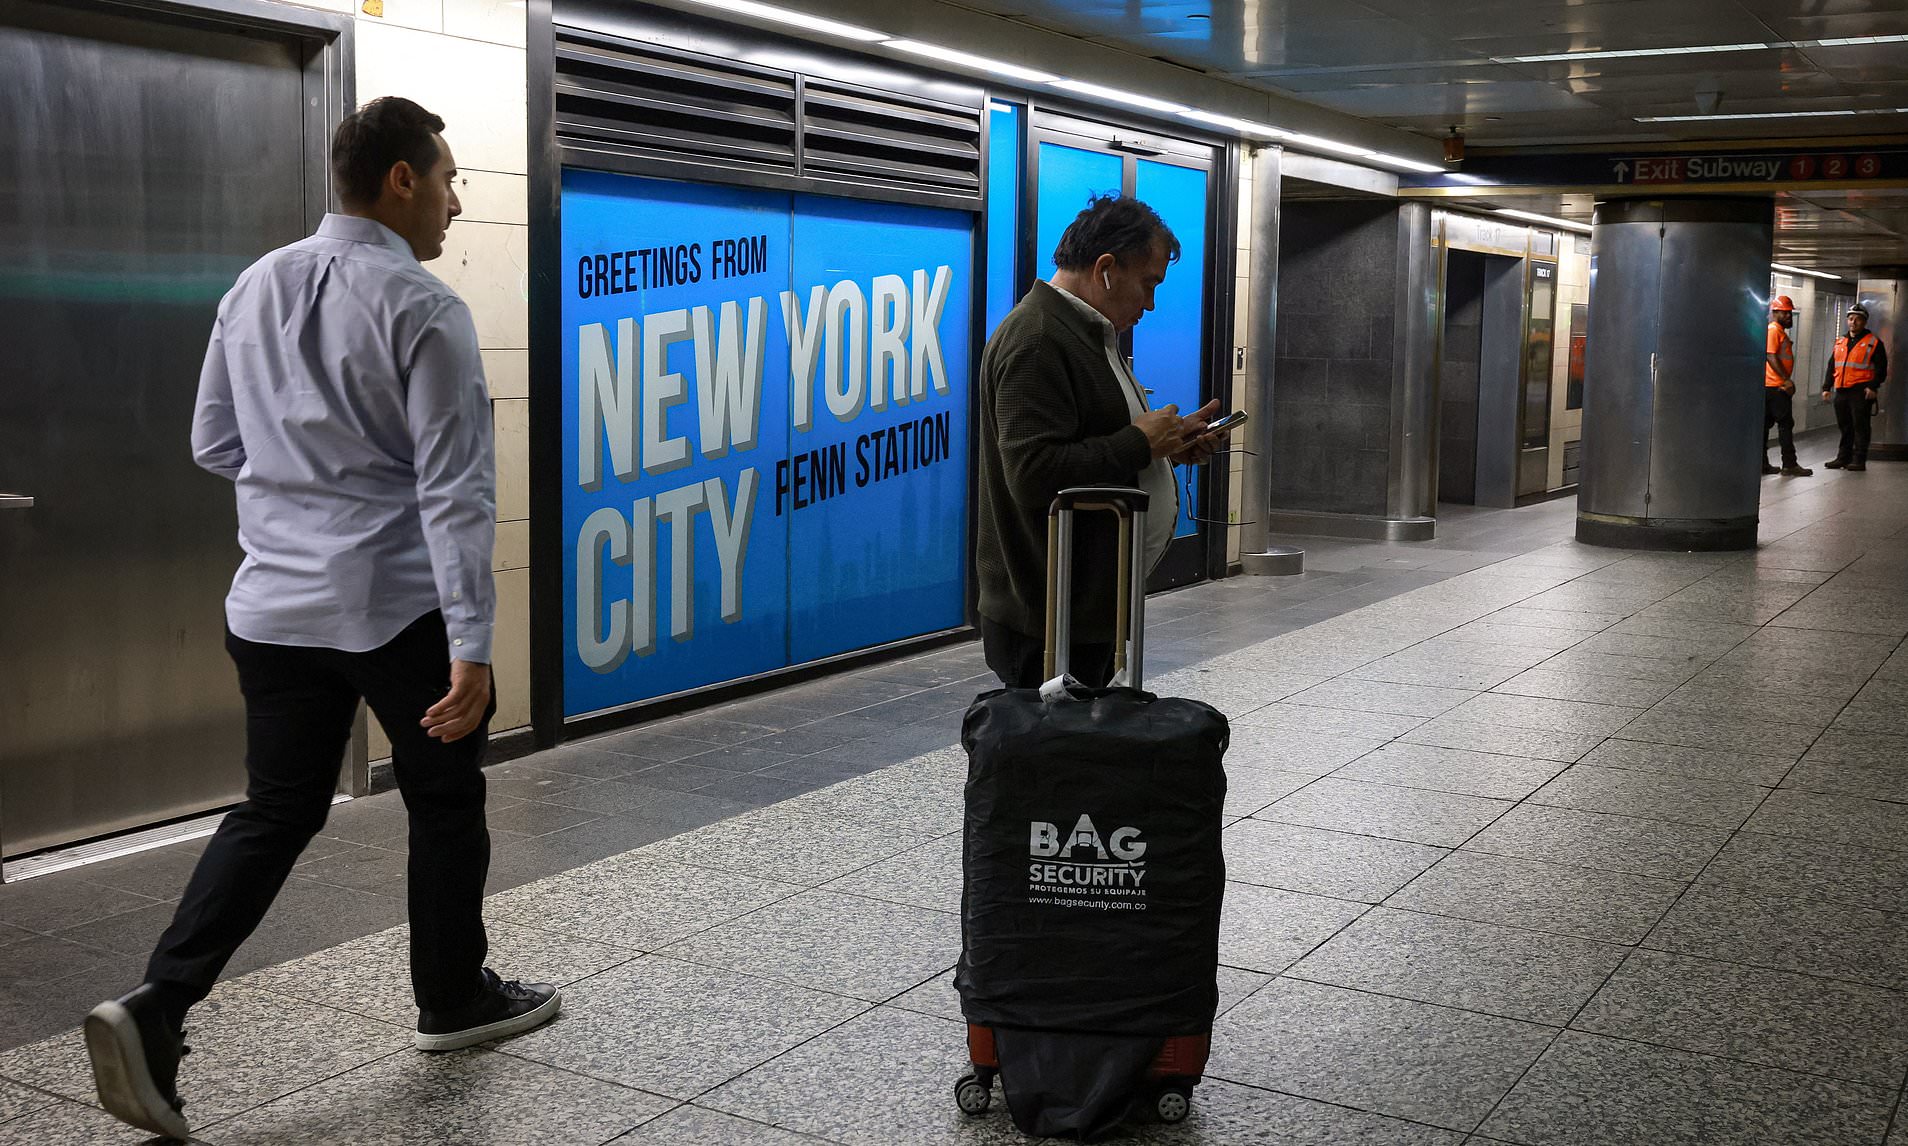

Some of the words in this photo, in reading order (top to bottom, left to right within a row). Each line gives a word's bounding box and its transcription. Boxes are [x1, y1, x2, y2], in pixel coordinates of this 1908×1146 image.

[1634, 159, 1679, 180] Exit
[1687, 158, 1781, 181] Subway
[1829, 160, 1841, 174] 2
[1862, 159, 1874, 173] 3
[578, 243, 701, 299] GREETINGS
[712, 235, 767, 280] FROM
[578, 296, 768, 492] NEW
[779, 264, 952, 432] YORK
[776, 442, 846, 517] PENN
[855, 411, 950, 488] STATION
[577, 467, 760, 674] CITY
[1029, 813, 1147, 861] BAG
[1029, 864, 1146, 887] SECURITY
[1029, 884, 1088, 895] PROTEGEMOS
[1104, 888, 1146, 896] EQUIPAJE
